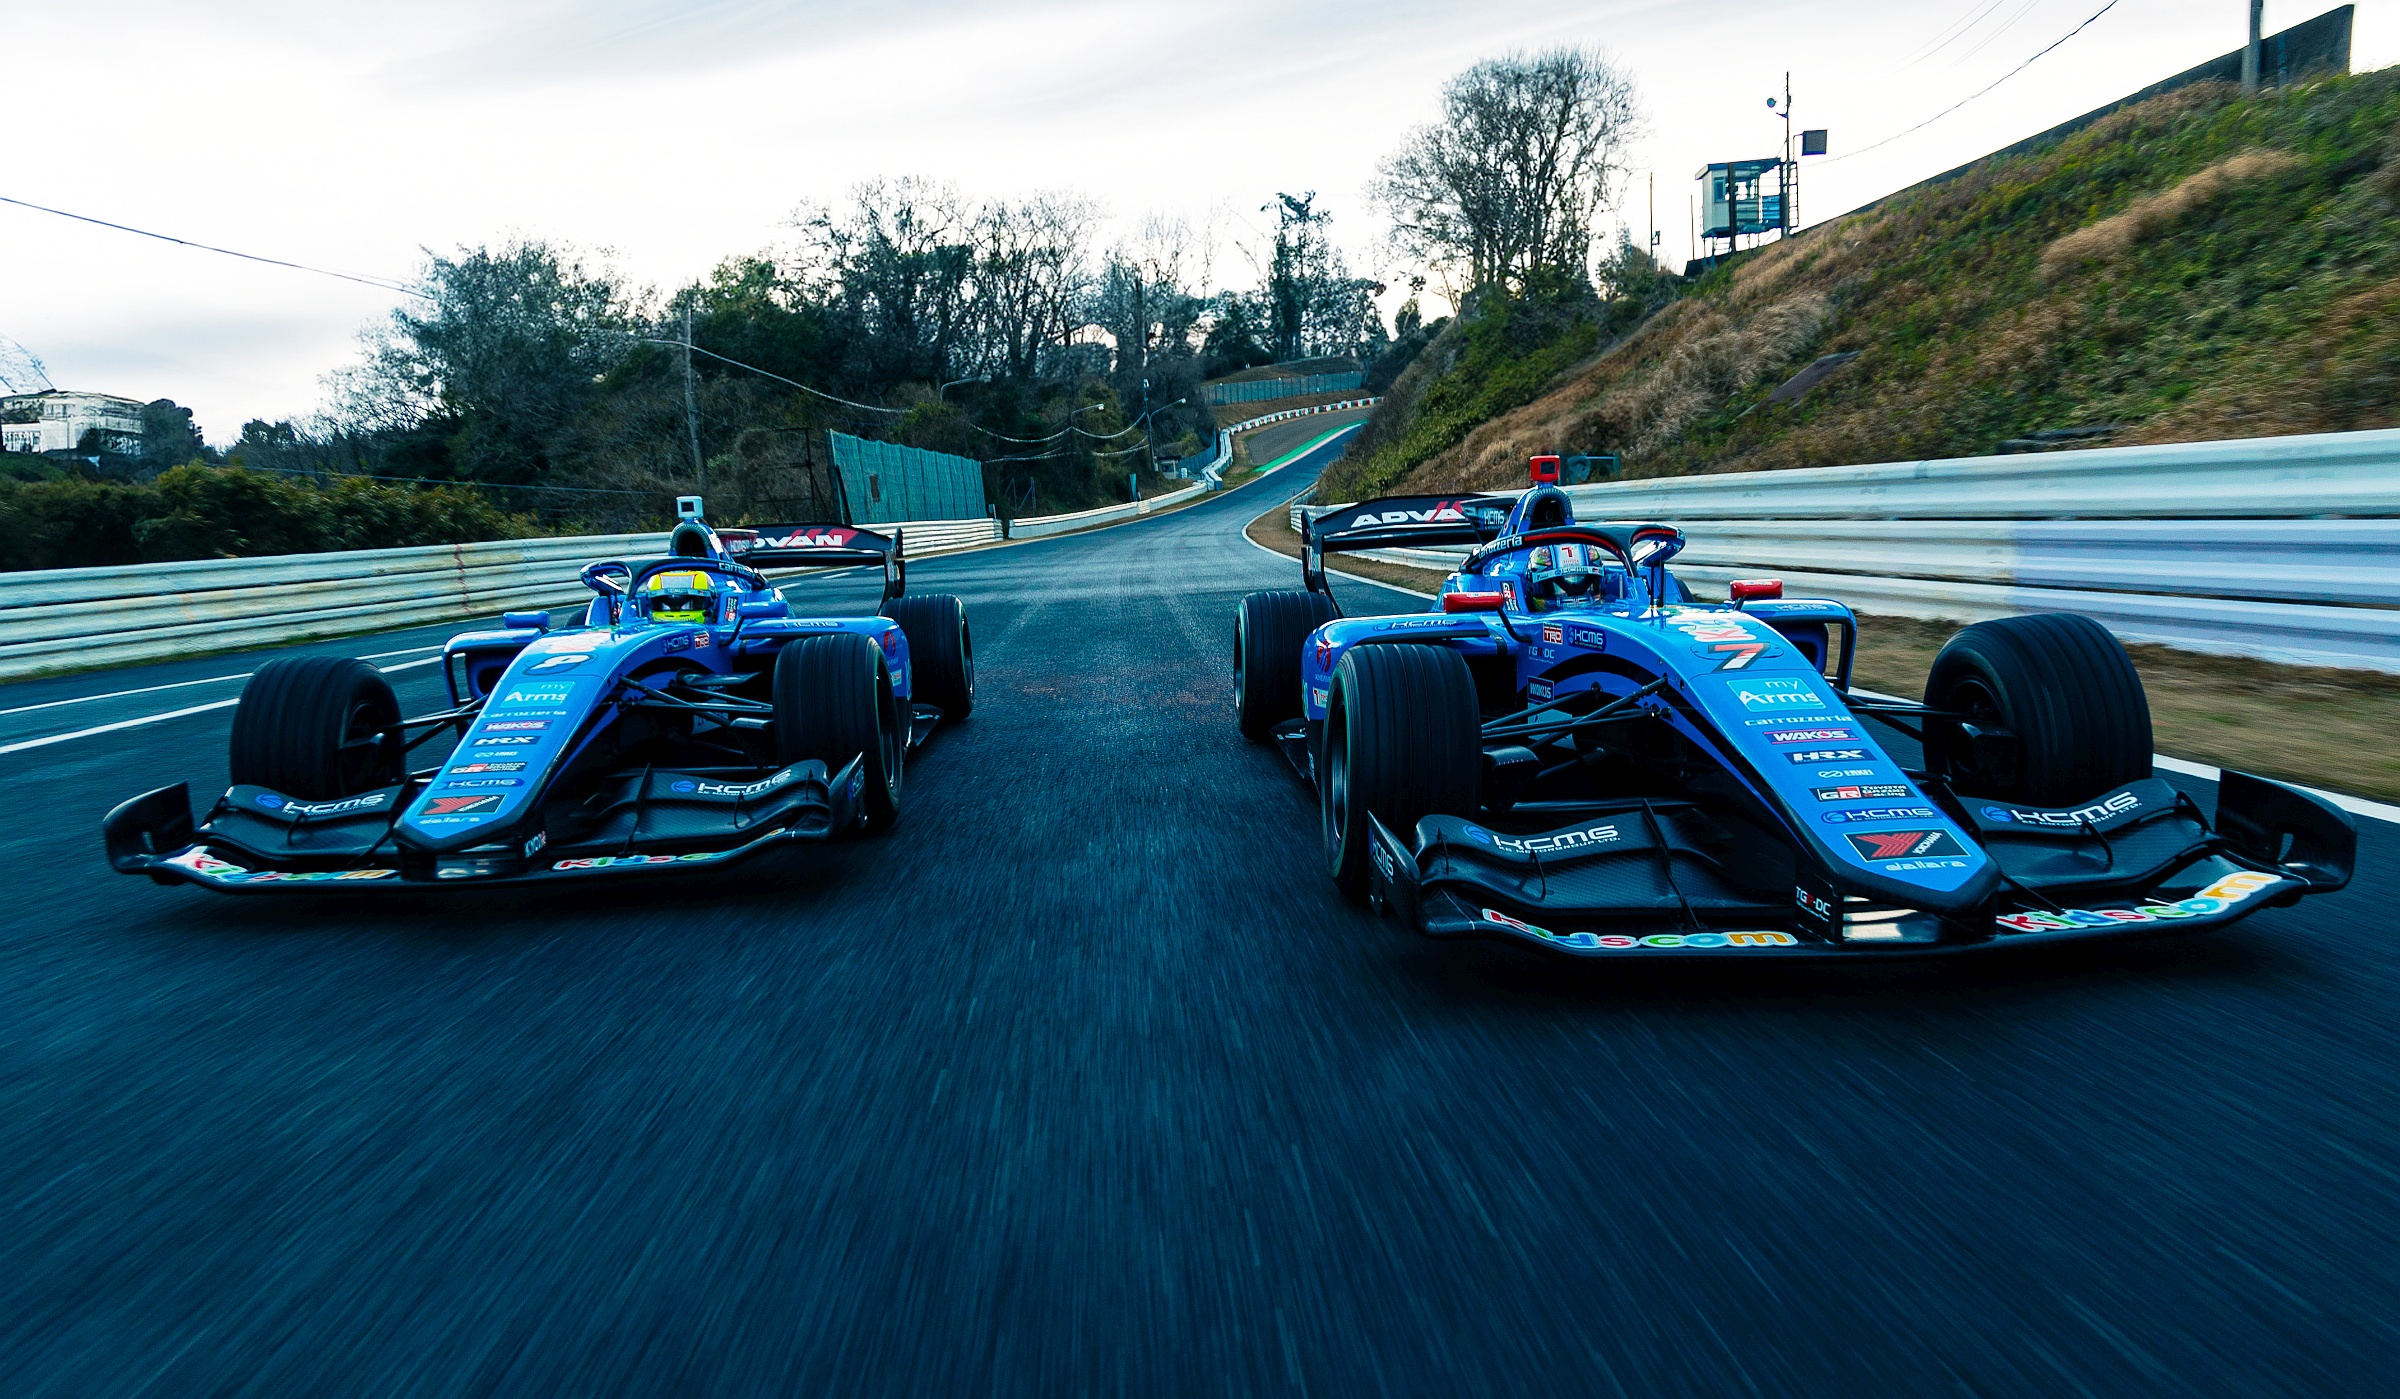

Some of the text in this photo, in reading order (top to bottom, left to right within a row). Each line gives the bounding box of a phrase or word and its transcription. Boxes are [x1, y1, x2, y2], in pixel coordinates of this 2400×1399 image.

[1350, 508, 1468, 528] ADVA
[1544, 628, 1562, 643] TRD
[1575, 629, 1603, 645] KCMG
[1707, 642, 1771, 672] 7
[1765, 680, 1798, 690] my
[504, 691, 568, 702] Arms
[1739, 690, 1822, 706] Arms
[1744, 714, 1853, 727] carrozzeria
[474, 736, 535, 746] HRX
[1793, 750, 1863, 762] HRX
[449, 778, 517, 787] KCMG
[698, 769, 791, 793] KCMG
[1821, 788, 1861, 799] GR
[283, 793, 386, 813] KCMG
[2011, 791, 2138, 822] KCMG
[1846, 808, 1933, 818] KCMG
[1492, 825, 1618, 850] KCMG
[1885, 860, 1968, 871] dallara
